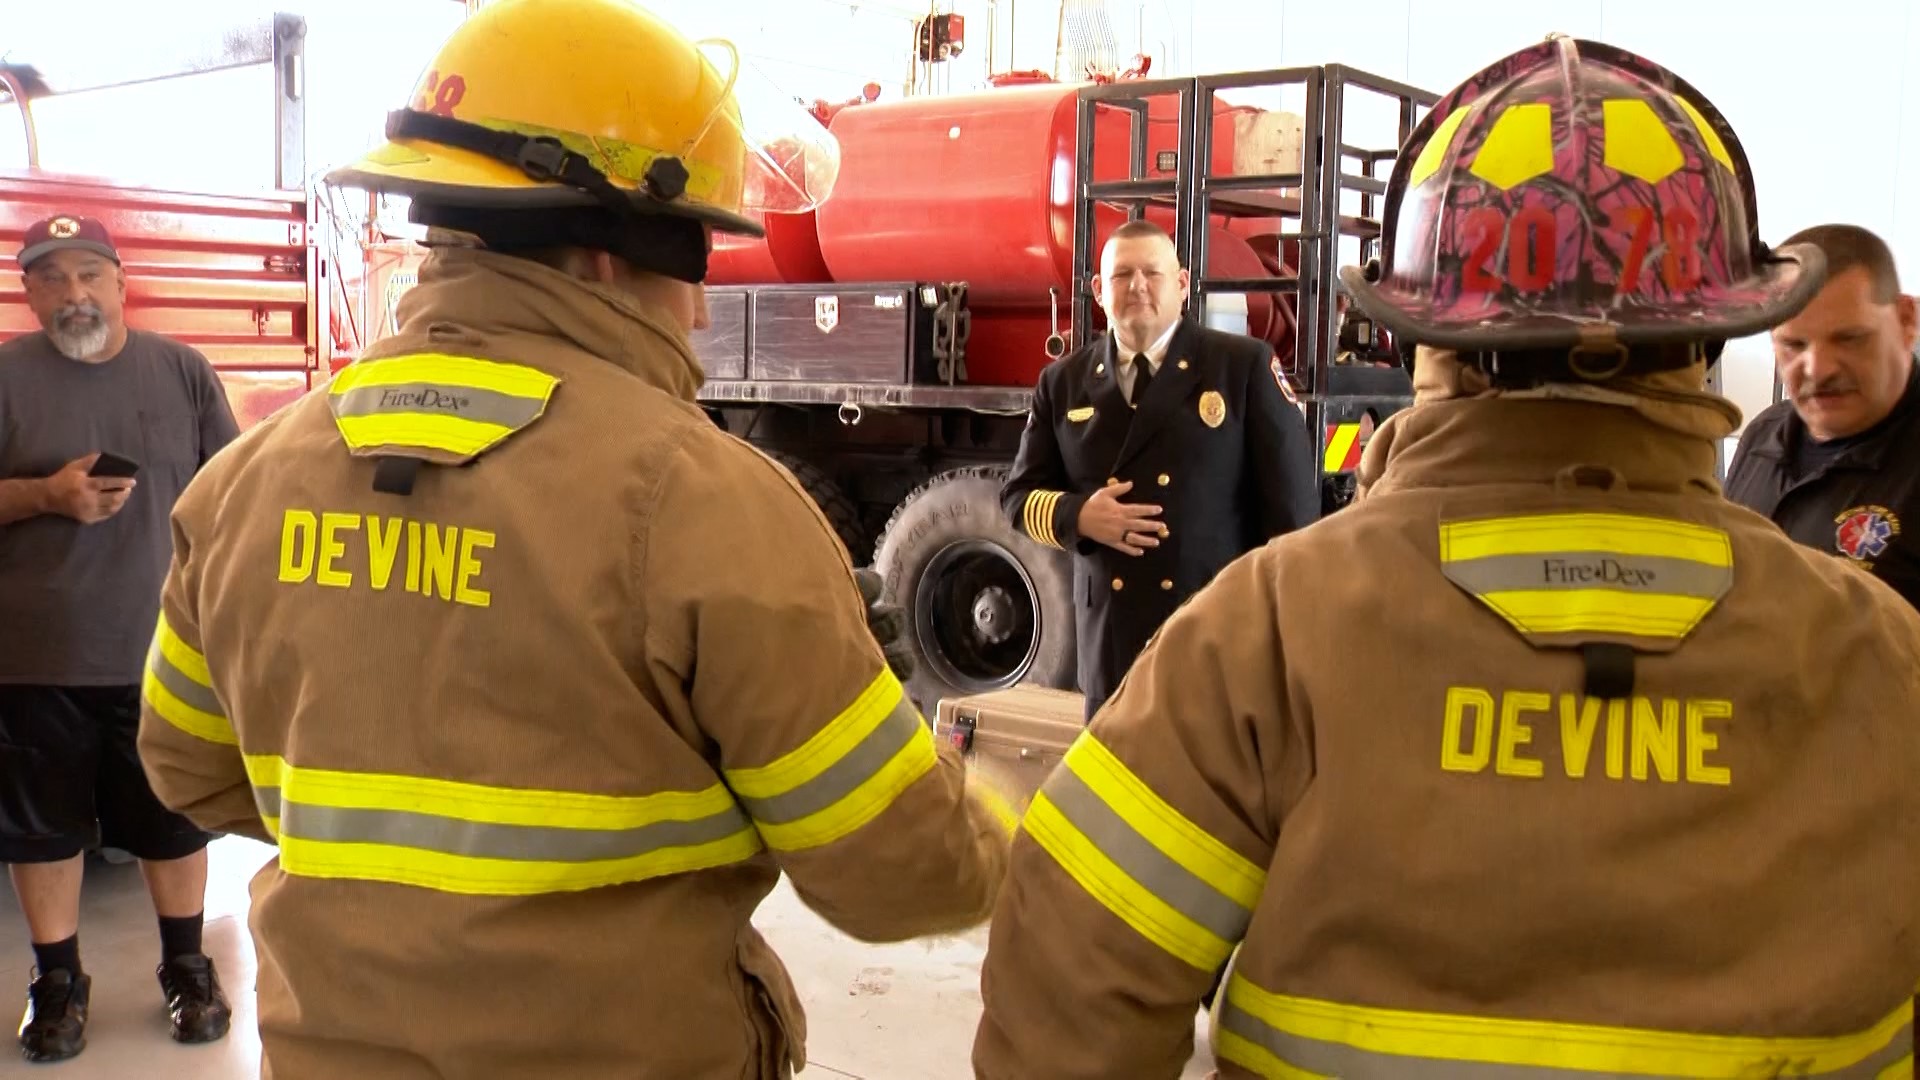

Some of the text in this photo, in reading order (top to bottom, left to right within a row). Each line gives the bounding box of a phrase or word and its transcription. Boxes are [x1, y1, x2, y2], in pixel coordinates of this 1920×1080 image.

[1461, 206, 1702, 294] 20 78
[278, 509, 496, 608] DEVINE
[1441, 687, 1732, 785] DEVINE
